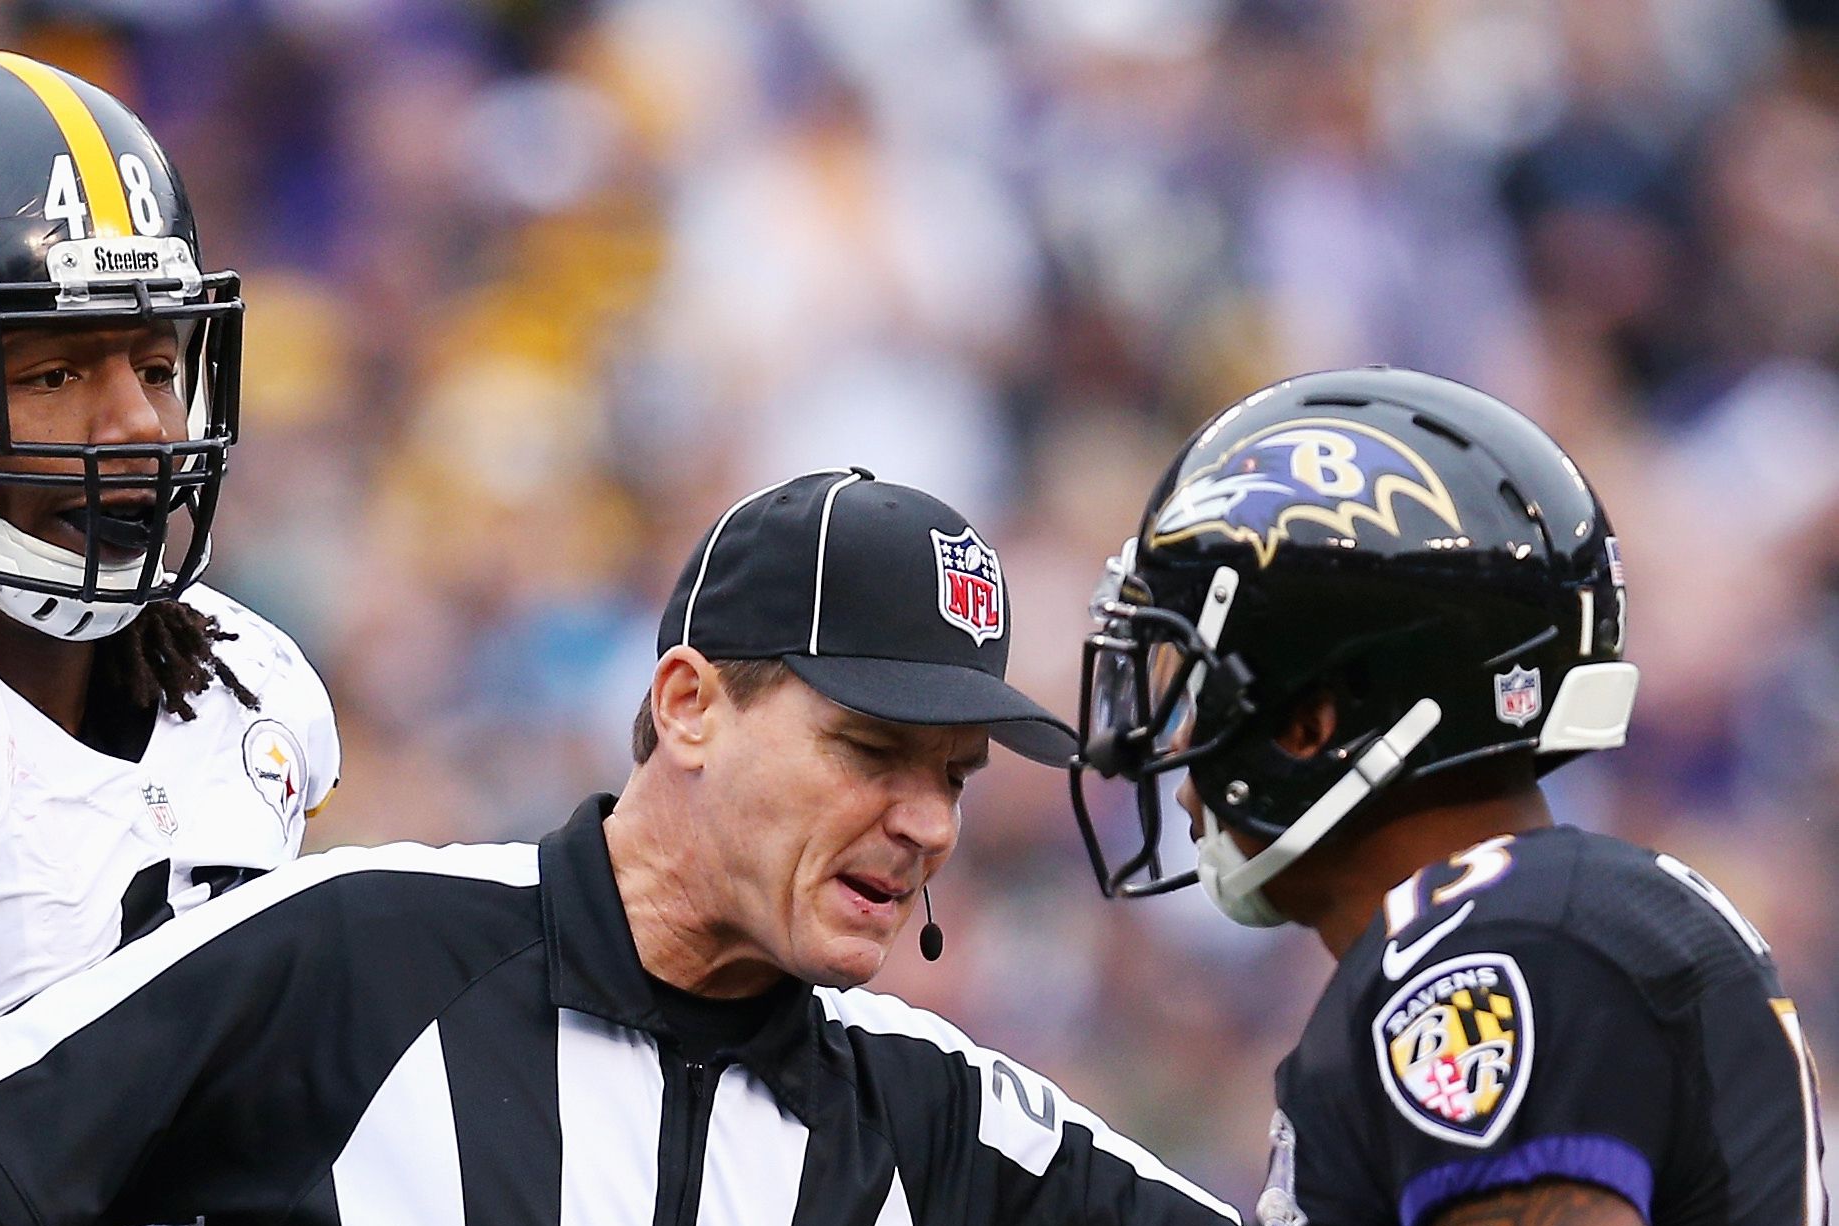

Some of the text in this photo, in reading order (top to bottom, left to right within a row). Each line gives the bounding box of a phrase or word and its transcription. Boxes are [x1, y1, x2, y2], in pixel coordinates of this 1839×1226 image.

[44, 153, 162, 239] 48
[94, 246, 159, 271] Steelers
[1254, 428, 1365, 498] B
[947, 571, 998, 628] NFL
[1385, 966, 1499, 1036] RAVENS
